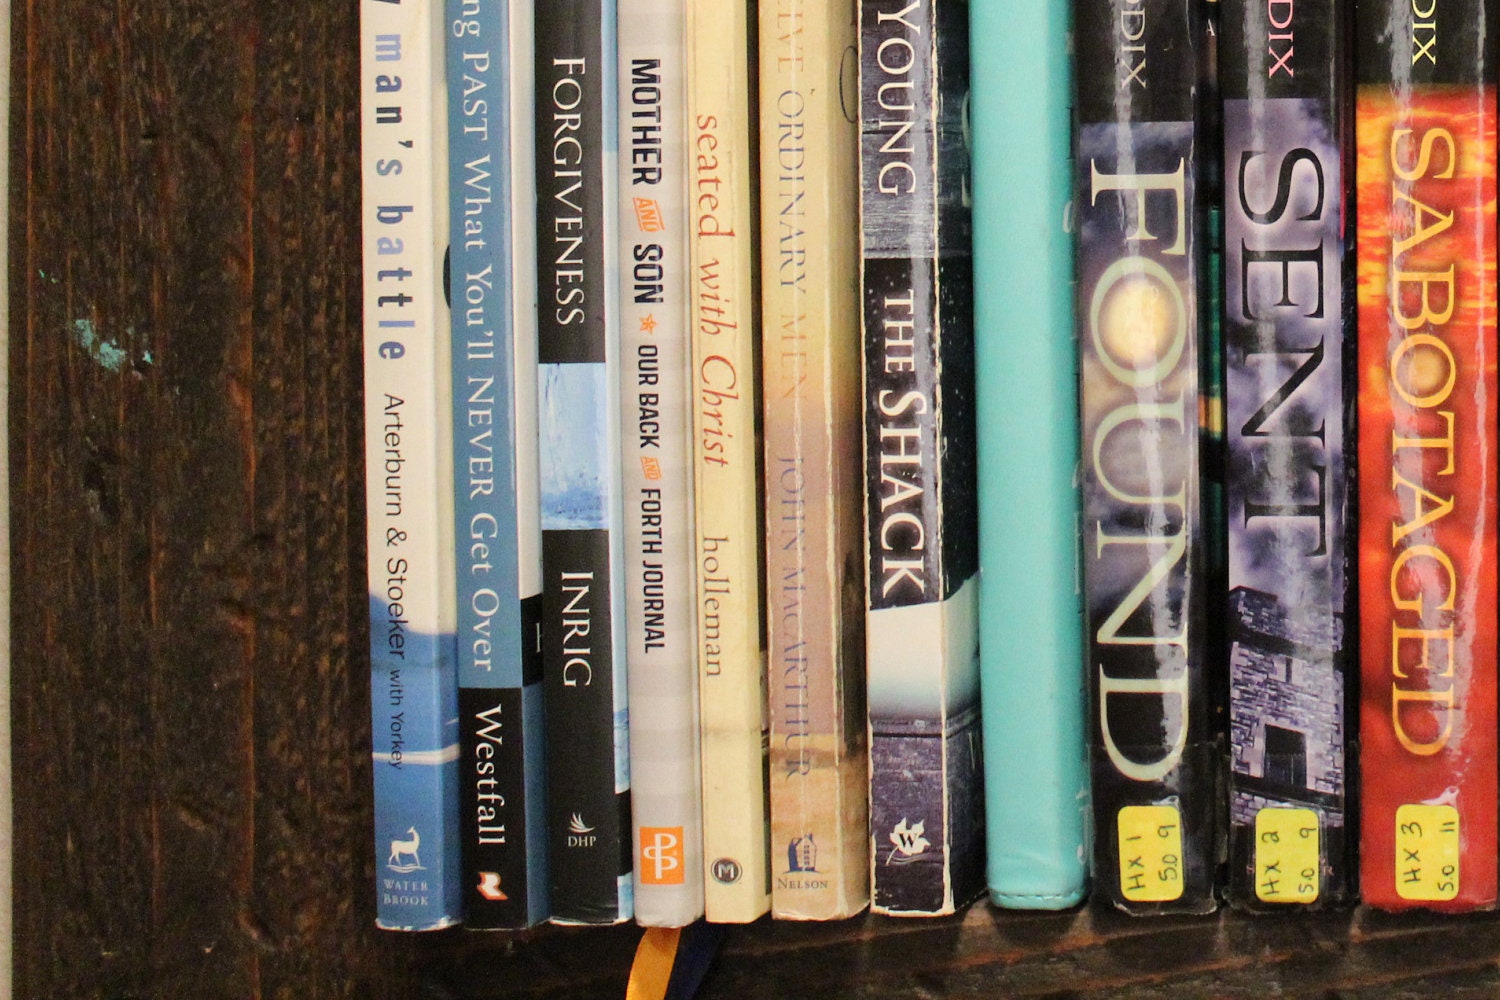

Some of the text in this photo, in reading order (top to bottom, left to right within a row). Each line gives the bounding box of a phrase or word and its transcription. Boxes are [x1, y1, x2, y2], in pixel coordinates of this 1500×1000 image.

[375, 34, 414, 177] man's
[461, 50, 490, 142] PAST
[462, 155, 494, 250] What
[552, 57, 586, 326] FORGIVENESS
[777, 90, 807, 295] ORDINARY
[376, 205, 416, 361] battle
[463, 264, 495, 361] You'll
[694, 115, 738, 468] seated with Christ
[632, 59, 665, 654] MOTHER AND SON OUR BACK AND FORTH JOURNAL
[780, 313, 808, 400] MEN
[1237, 147, 1328, 558] SENT
[466, 376, 496, 500] NEVER
[878, 290, 927, 598] THE SHACK
[1089, 157, 1190, 784] FOUND
[1390, 126, 1458, 757] SABOTAGED
[469, 513, 499, 577] Get
[777, 457, 806, 551] JOHN
[382, 392, 410, 771] Arterburn & Stoeker with Yorkey
[471, 587, 500, 672] Over
[559, 571, 594, 688] INRIG
[701, 535, 731, 677] holleman
[474, 704, 507, 846] Westfall
[1401, 821, 1423, 838] 3
[383, 878, 428, 892] WATER
[383, 892, 429, 906] BROOK
[567, 835, 596, 848] DHP
[777, 876, 828, 891] NELSON
